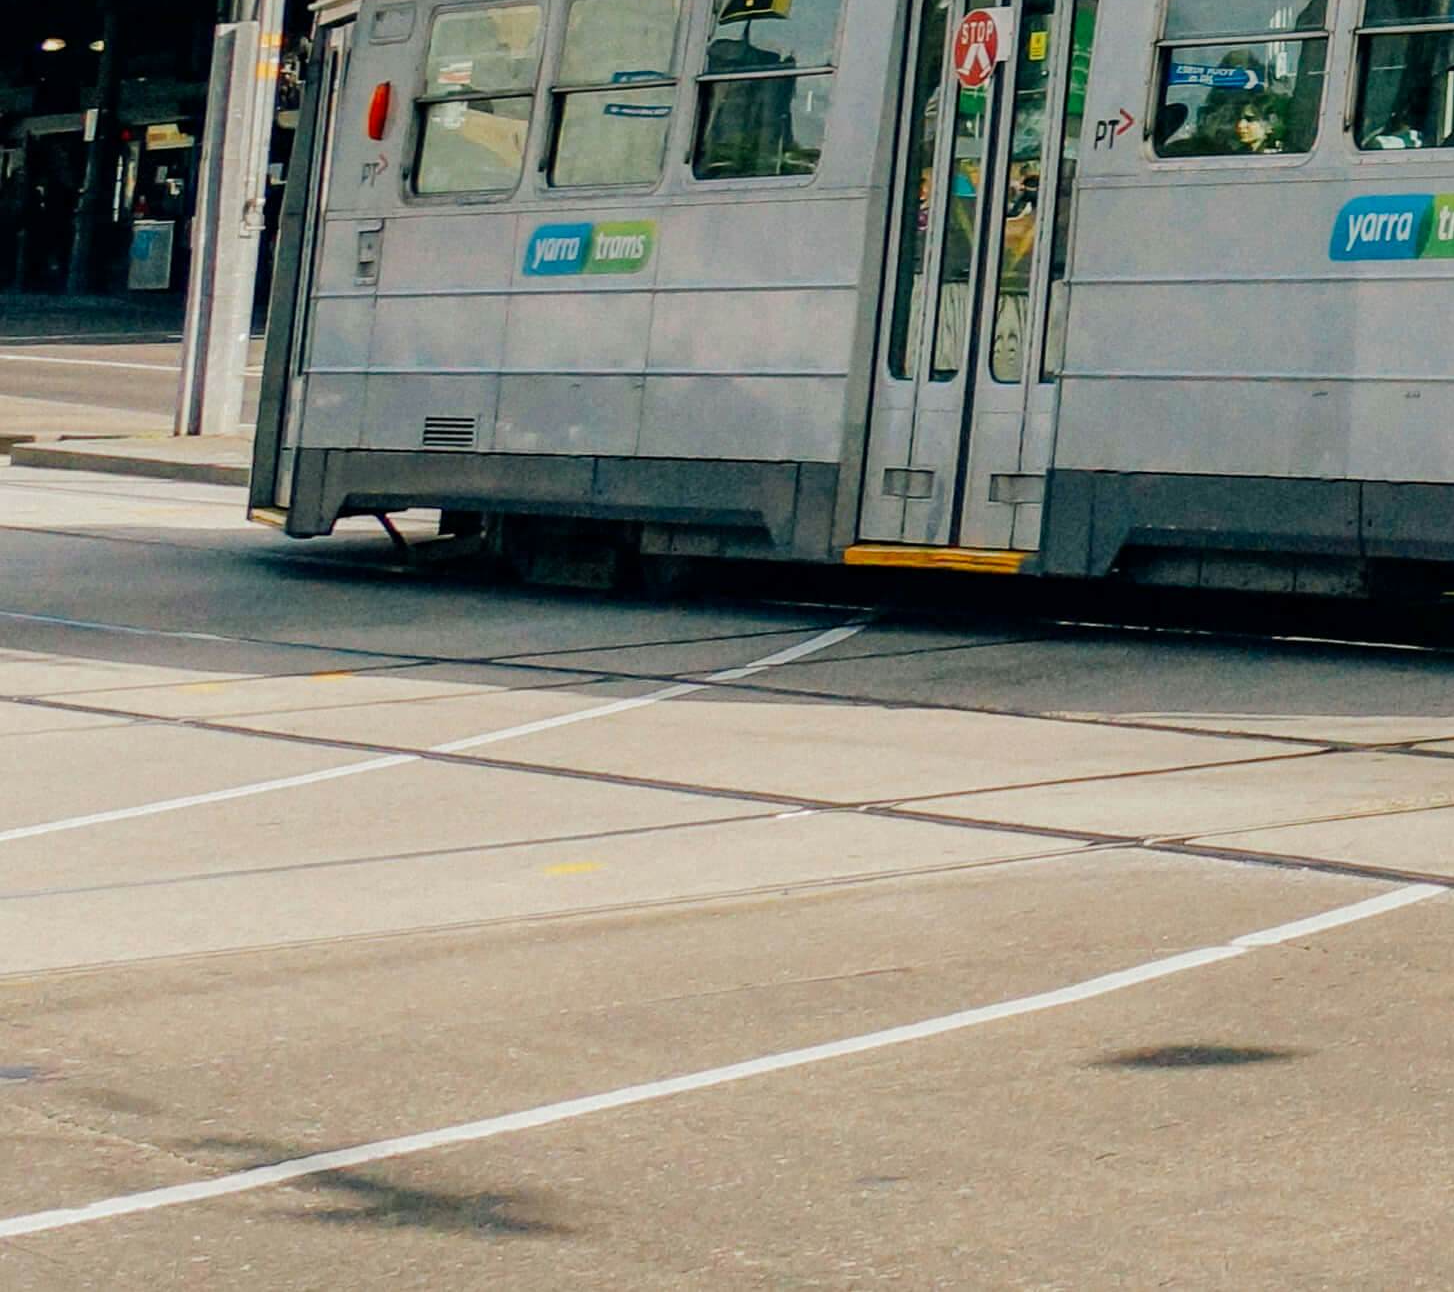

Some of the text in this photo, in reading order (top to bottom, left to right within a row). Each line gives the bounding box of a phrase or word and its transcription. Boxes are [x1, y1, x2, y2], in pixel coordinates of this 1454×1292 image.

[961, 20, 994, 45] STOP
[1345, 211, 1413, 252] yarra
[531, 232, 646, 270] yarra trams
